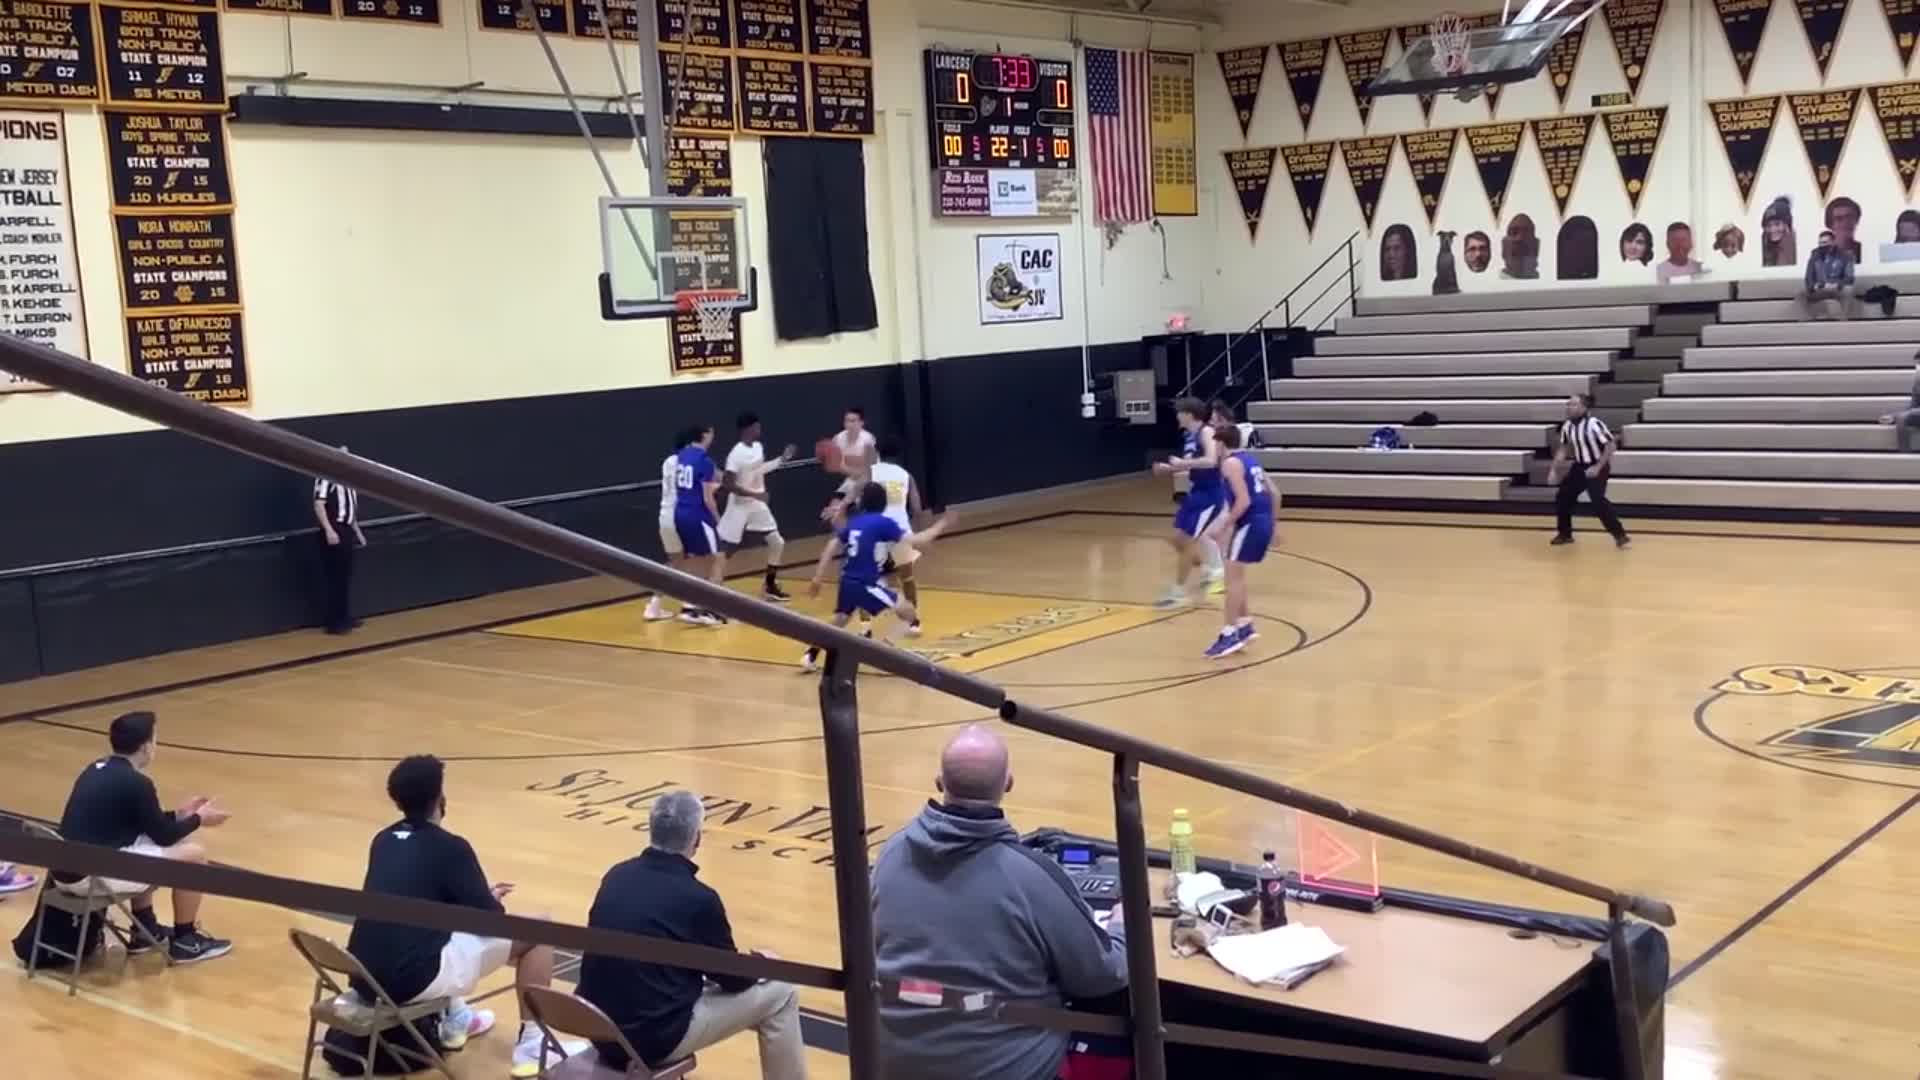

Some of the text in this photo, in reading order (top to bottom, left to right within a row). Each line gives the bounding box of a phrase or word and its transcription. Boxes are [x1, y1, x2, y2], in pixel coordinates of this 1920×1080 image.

[357, 1, 423, 15] 20 12
[26, 20, 73, 32] TRACK
[120, 26, 202, 40] BOYS TRACK
[70, 35, 79, 47] A
[118, 38, 207, 54] NON-PUBLIC A
[24, 46, 79, 60] CHAMPION
[121, 52, 207, 67] STATE CHAMPION
[935, 55, 971, 70] LANCERS
[1039, 62, 1068, 76] VISITOR
[56, 66, 76, 77] 07
[128, 70, 205, 84] 11 12
[992, 57, 1031, 89] 7:33
[6, 81, 97, 96] METER DASH
[157, 88, 202, 100] METER
[956, 72, 970, 103] 0
[1056, 79, 1068, 108] 0
[1797, 101, 1851, 114] DIVISION
[1608, 110, 1660, 123] SOFTBALL
[1720, 109, 1772, 121] DIVISION
[126, 116, 204, 129] JOSHUA TAYLOR
[1610, 119, 1659, 132] DIVISION
[0, 120, 58, 140] IONS
[1538, 128, 1586, 139] DIVISION
[184, 132, 210, 142] TRACK
[192, 144, 199, 154] A
[944, 135, 962, 156] 00
[1053, 138, 1069, 158] 00
[127, 157, 210, 169] STATE CHAMPION
[20, 168, 58, 185] JERSEY
[133, 175, 208, 186] 20 15
[1010, 184, 1027, 192] Bank
[0, 189, 62, 206] TBALL
[129, 192, 216, 203] 110 HURDLES
[138, 220, 164, 233] NORA
[188, 238, 224, 248] COUNTRY
[9, 254, 57, 265] FURCH
[133, 254, 225, 267] NON-PUBLIC A
[1021, 249, 1053, 270] CAC
[11, 269, 59, 279] FURCH
[133, 270, 227, 284] STATE CHAMPIONS
[11, 283, 77, 294] KARPELL
[140, 290, 160, 300] 20
[13, 297, 62, 308] KEHOE
[1028, 288, 1046, 306] SJV
[16, 327, 57, 338] MIKOS
[137, 319, 164, 333] KATIE
[205, 332, 231, 342] TRACK
[141, 345, 233, 359] NON-PUBLIC A
[144, 358, 232, 373] STATE CHAMPION
[213, 388, 246, 399] DASH
[677, 464, 694, 489] 20
[847, 530, 863, 557] 5
